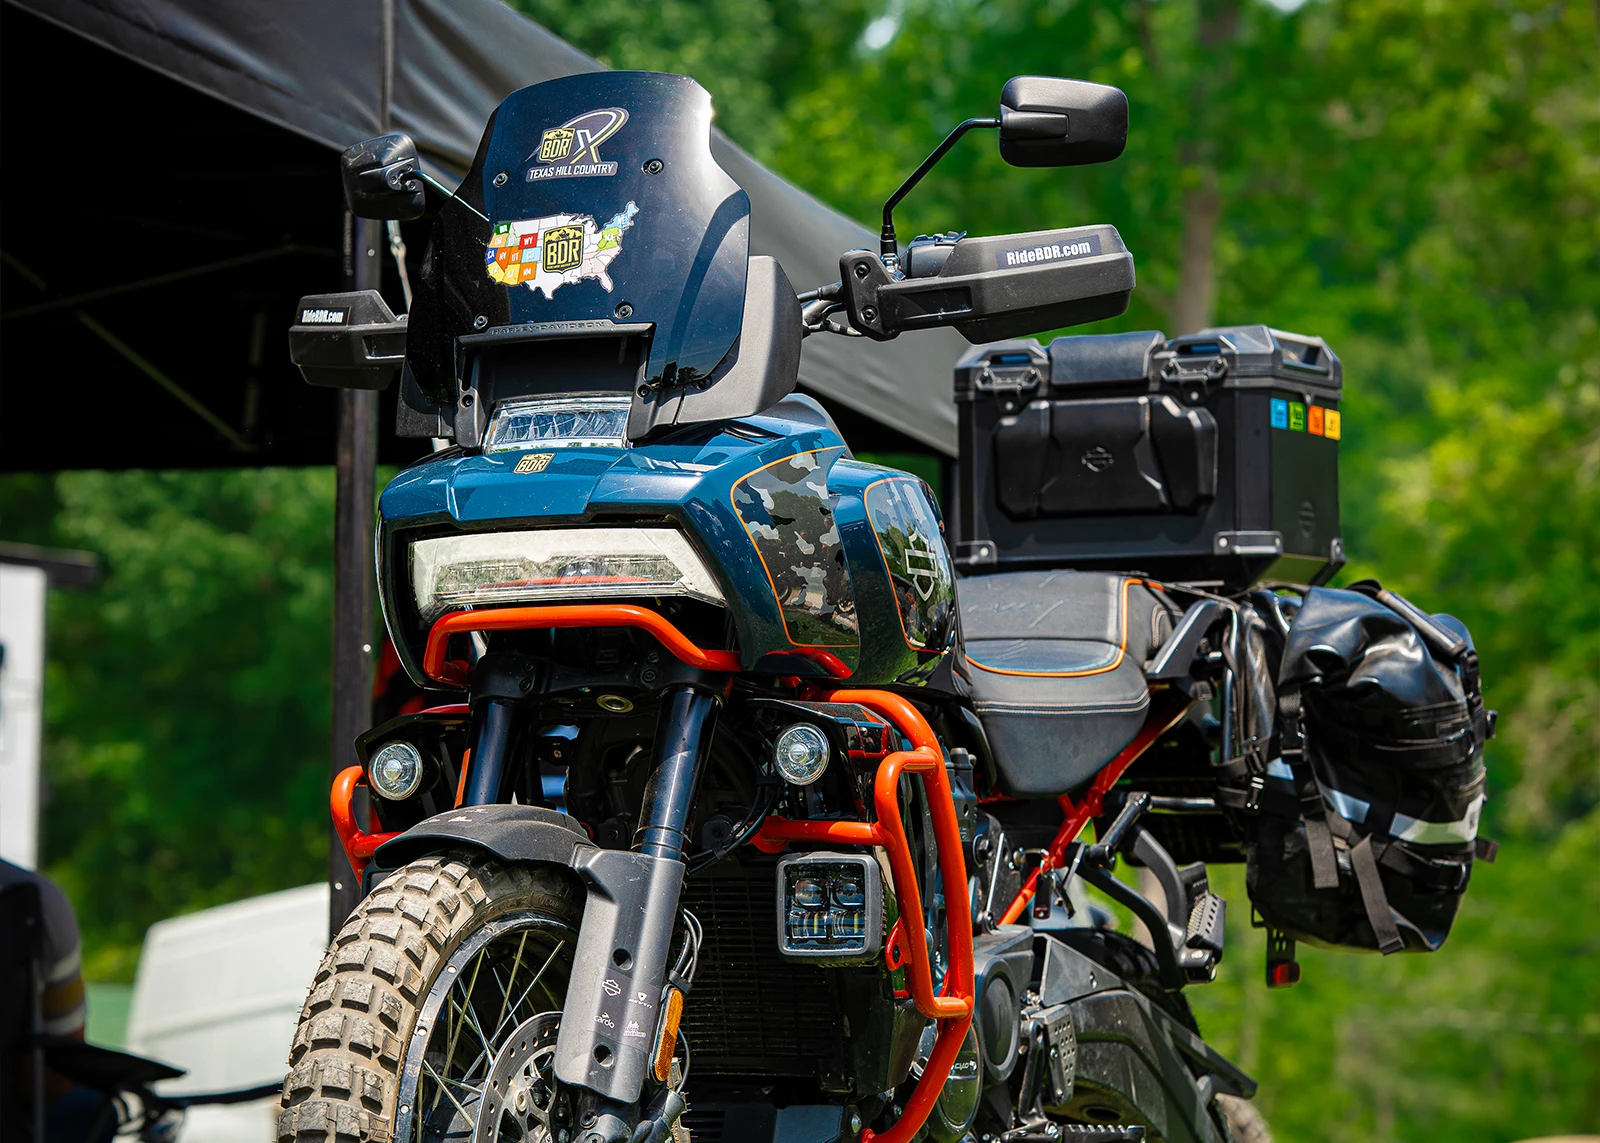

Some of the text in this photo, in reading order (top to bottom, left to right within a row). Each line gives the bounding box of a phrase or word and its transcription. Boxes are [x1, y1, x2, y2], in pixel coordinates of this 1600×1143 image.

[541, 138, 571, 159] BDR
[529, 164, 613, 180] TEXAS HILL COUNTRY
[523, 236, 534, 246] WY
[487, 249, 495, 259] CA
[499, 251, 507, 261] NV
[511, 252, 519, 262] UT
[547, 239, 579, 265] BDR
[1006, 241, 1091, 265] RideBDR.com
[301, 310, 343, 323] RideBDR.com
[517, 460, 548, 471] BDR
[593, 1015, 615, 1029] cardo
